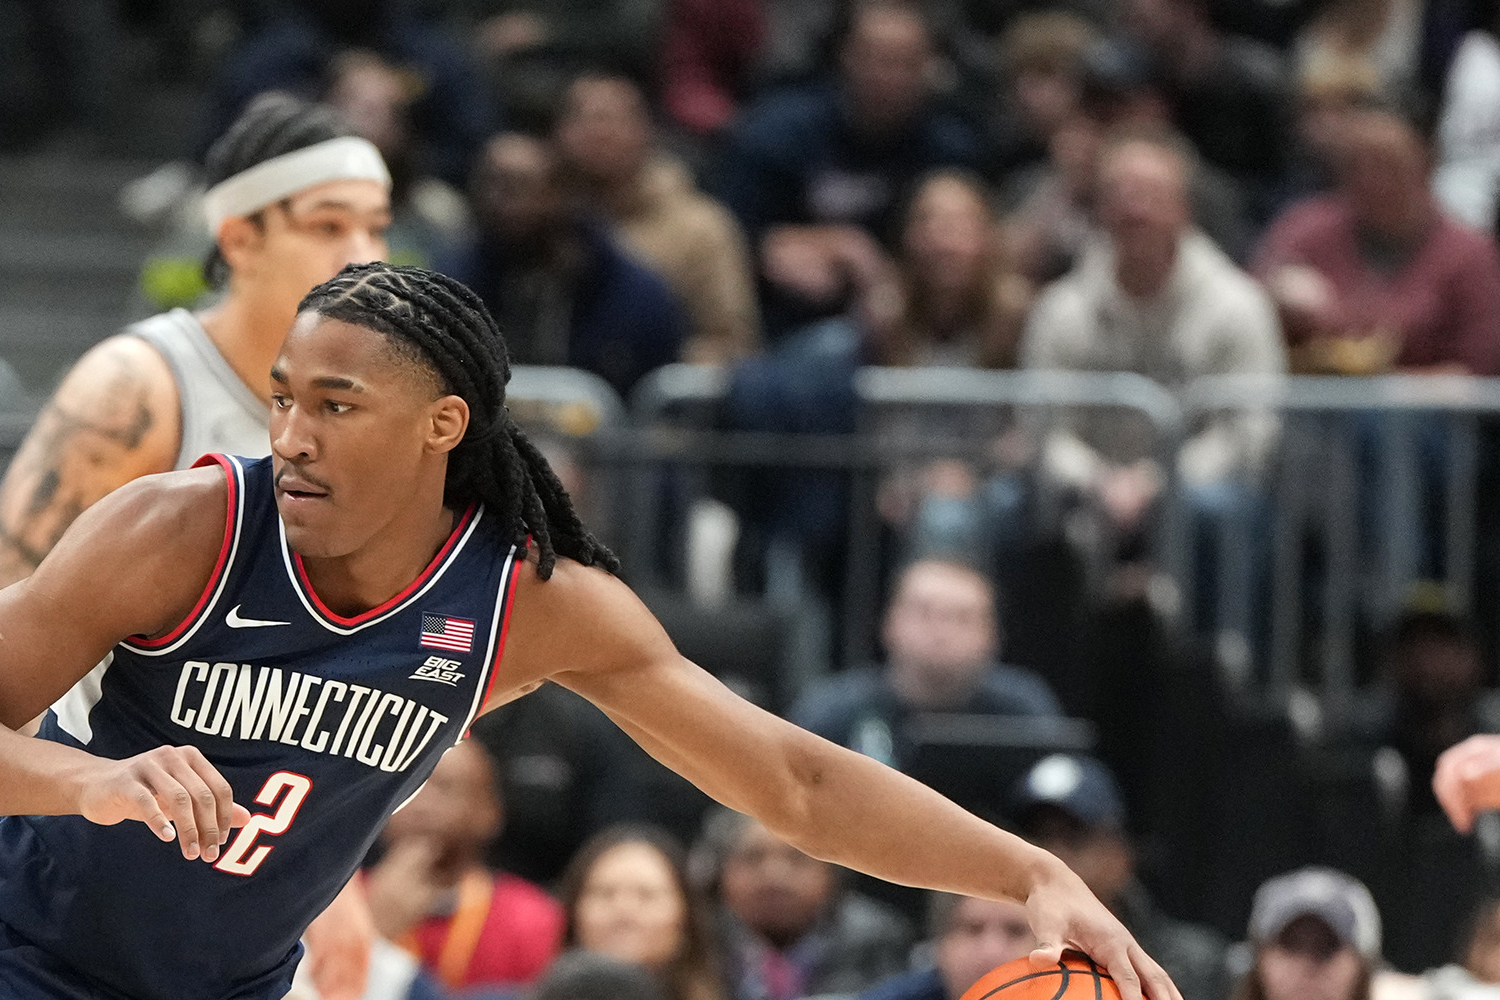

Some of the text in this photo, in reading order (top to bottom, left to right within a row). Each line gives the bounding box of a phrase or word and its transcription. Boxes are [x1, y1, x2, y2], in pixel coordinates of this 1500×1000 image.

[414, 665, 466, 683] EAST
[423, 655, 462, 671] BIG
[170, 660, 449, 773] CONNECTICUT
[213, 770, 313, 876] 2
